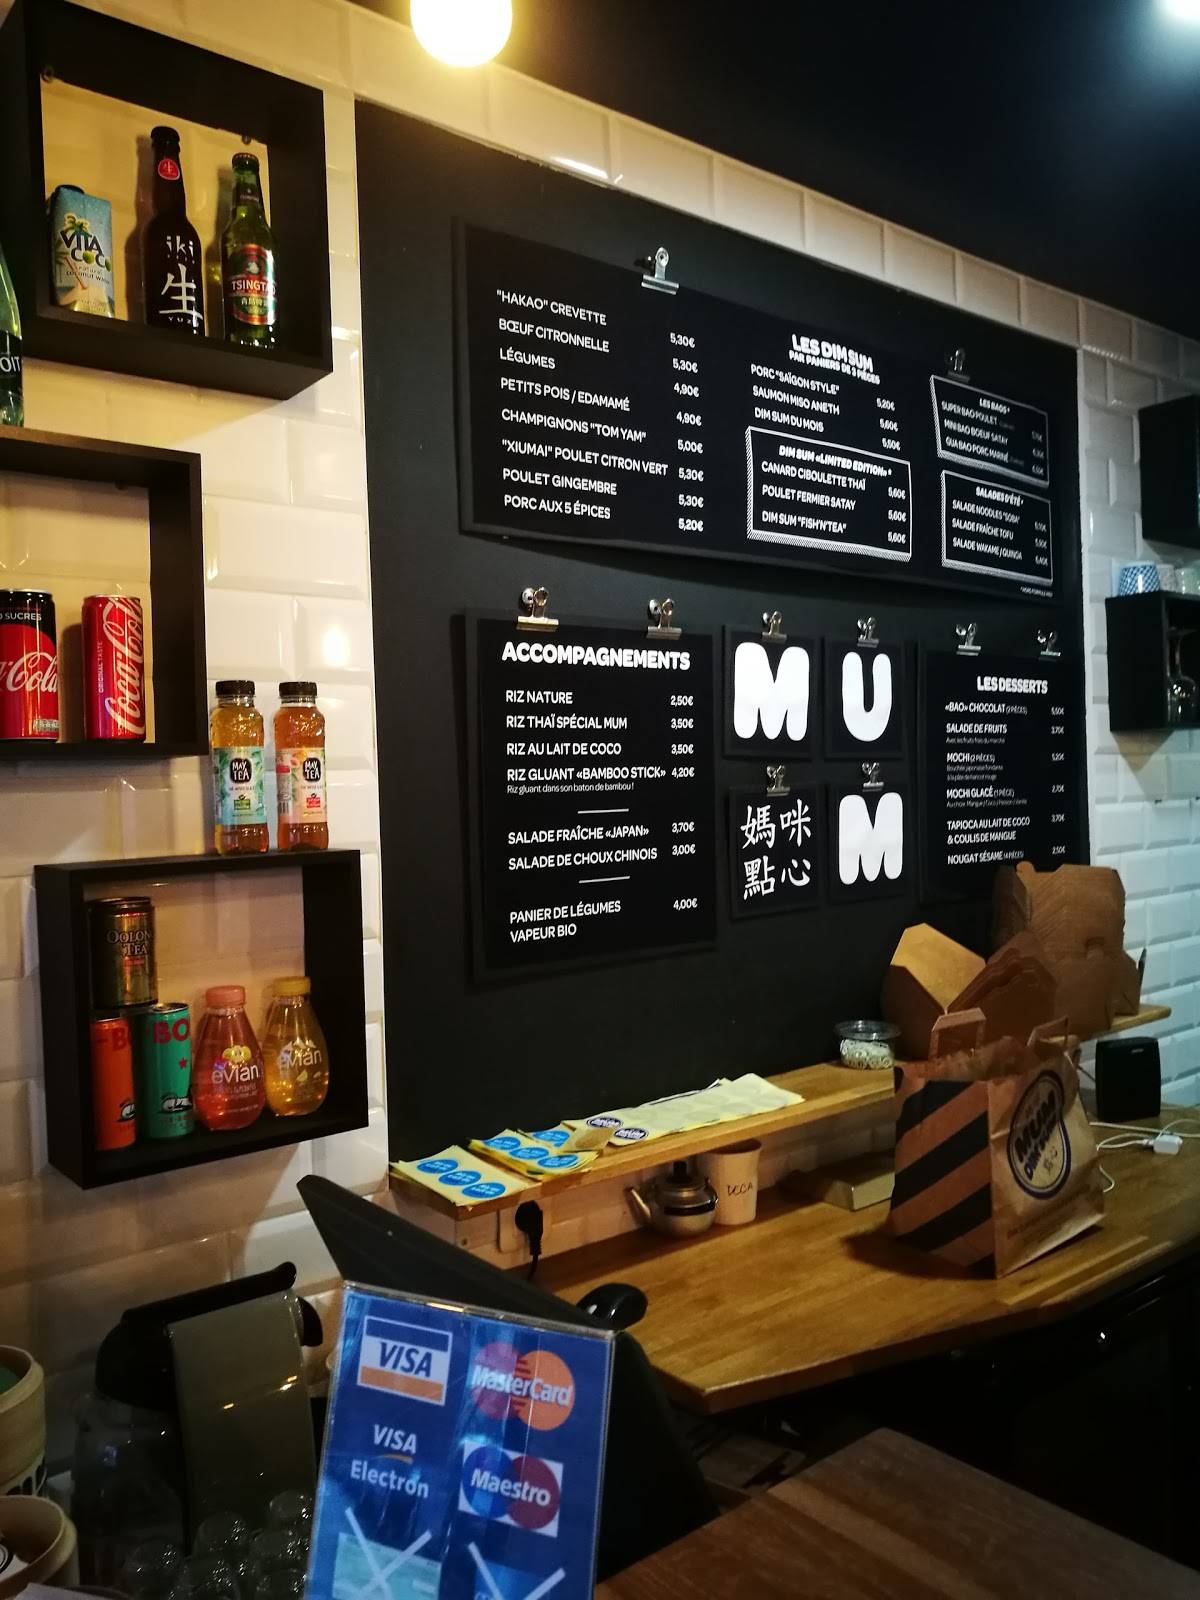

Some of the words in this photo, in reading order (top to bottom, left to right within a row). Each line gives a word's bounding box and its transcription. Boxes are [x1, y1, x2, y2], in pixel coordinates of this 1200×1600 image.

[60, 230, 103, 255] VITA
[166, 235, 195, 257] iki
[159, 263, 203, 320] 生
[497, 290, 548, 310] "HAKAO"
[551, 302, 607, 326] CREVETTE
[535, 326, 610, 353] CITRONNELLE
[670, 332, 695, 348] 5,30€
[500, 348, 556, 369] LÉGUMES
[789, 350, 805, 364] PAR
[792, 334, 819, 356] LES
[821, 341, 847, 362] DIM
[848, 350, 873, 372] SUM
[673, 358, 698, 373] 5,30€
[751, 363, 774, 379] PORC
[775, 371, 810, 389] "SAÏGON
[810, 380, 840, 395] STYLE"
[501, 378, 542, 396] PETITS
[544, 385, 570, 401] POIS
[578, 391, 630, 411] EDAMAMÉ
[673, 382, 699, 398] 4,90€
[753, 385, 790, 404] SAUMON
[790, 395, 810, 410] MISO
[811, 400, 840, 415] ANETH
[501, 409, 589, 434] CHAMPIGNONS
[590, 423, 619, 439] "TOM
[620, 428, 647, 443] YAM"
[676, 411, 702, 426] 4,90€
[755, 407, 771, 420] DIM
[772, 411, 790, 424] SUM
[791, 415, 802, 427] DU
[803, 418, 824, 432] MOIS
[677, 439, 703, 454] 5,00€
[779, 445, 795, 458] DIM
[796, 449, 815, 462] SUM
[502, 439, 552, 457] "XIUMAI"
[554, 447, 599, 464] POULET
[601, 455, 641, 471] CITRON
[642, 462, 668, 476] VERT
[503, 468, 550, 486] POULET
[552, 474, 617, 495] GINGEMBRE
[678, 468, 704, 482] 5,30€
[762, 461, 797, 478] CANARD
[798, 468, 847, 487] CIBOULETTE
[847, 478, 866, 490] THAÏ
[678, 494, 704, 508] 5,30€
[762, 485, 796, 500] POULET
[797, 490, 830, 507] FERMIER
[831, 497, 856, 510] SATAY
[505, 495, 537, 510] PORC
[539, 500, 563, 513] AUX
[564, 502, 572, 515] 5
[573, 501, 610, 519] ÉPICES
[952, 500, 976, 514] SALADE
[678, 518, 704, 532] 5,20€
[762, 511, 778, 524] DIM
[779, 514, 797, 527] SUM
[952, 518, 976, 532] SALADE
[953, 537, 976, 551] SALADE
[5, 612, 42, 621] SUCRES
[502, 641, 691, 671] ACCOMPAGNEMENTS
[734, 641, 810, 741] M
[842, 651, 892, 742] U
[977, 676, 998, 692] LES
[999, 677, 1048, 694] DESSERTS
[506, 690, 525, 703] RIZ
[526, 691, 573, 704] NATURE
[670, 695, 694, 707] 2,50€
[969, 703, 1006, 713] CHOCOLAT
[506, 716, 525, 729] RIZ
[527, 713, 556, 729] THAÏ
[557, 713, 602, 729] SPÉCIAL
[604, 717, 627, 729] MUM
[671, 718, 694, 729] 3,50€
[946, 723, 973, 734] SALADE
[974, 724, 984, 733] DE
[984, 724, 1007, 734] FRUITS
[507, 743, 526, 755] RIZ
[528, 743, 545, 755] AU
[547, 743, 571, 755] LAIT
[573, 743, 589, 755] DE
[590, 743, 622, 755] COCO
[671, 744, 694, 755] 3,50€
[232, 760, 247, 771] MAY
[304, 760, 318, 770] MAY
[947, 753, 970, 762] MOCHI
[233, 769, 249, 781] TEA
[305, 769, 320, 780] TEA
[507, 769, 526, 782] RIZ
[528, 767, 574, 781] GLUANT
[576, 766, 630, 780] «BAMBOO
[631, 766, 666, 779] STICK»
[671, 767, 695, 778] 4,20€
[507, 784, 518, 794] Riz
[519, 783, 542, 796] gluant
[542, 783, 560, 793] dans
[573, 783, 594, 792] baton
[595, 783, 604, 791] de
[947, 789, 970, 799] MOCHI
[971, 786, 993, 798] GLACÉ
[671, 821, 695, 833] 3,70€
[947, 820, 978, 830] TAPIOCA
[979, 820, 988, 829] AU
[988, 818, 1002, 828] LAIT
[1003, 818, 1012, 827] DE
[1012, 816, 1030, 827] COCO
[508, 829, 554, 845] SALADE
[556, 825, 604, 842] FRAÎCHE
[605, 824, 649, 839] «JAPAN»
[838, 792, 903, 885] M
[947, 835, 953, 844] &
[954, 833, 980, 844] COULIS
[981, 833, 989, 842] DE
[990, 831, 1016, 841] MANGUE
[672, 844, 696, 856] 3,00€
[509, 855, 555, 870] SALADE
[557, 855, 572, 866] DE
[573, 850, 614, 865] CHOUX
[614, 847, 657, 861] CHINOIS
[948, 854, 978, 865] NOUGAT
[510, 907, 552, 924] PANIER
[553, 906, 569, 919] DE
[570, 900, 621, 917] LÉGUMES
[673, 898, 698, 911] 4,00€
[510, 925, 556, 943] VAPEUR
[557, 923, 577, 937] BIO
[123, 943, 148, 956] TEA
[278, 1048, 322, 1069] evian
[212, 1063, 259, 1084] evian
[377, 1342, 431, 1378] VISA
[471, 1364, 573, 1407] MasterCard
[373, 1424, 418, 1454] VISA
[350, 1459, 429, 1499] Electron
[470, 1468, 551, 1507] Maestro
